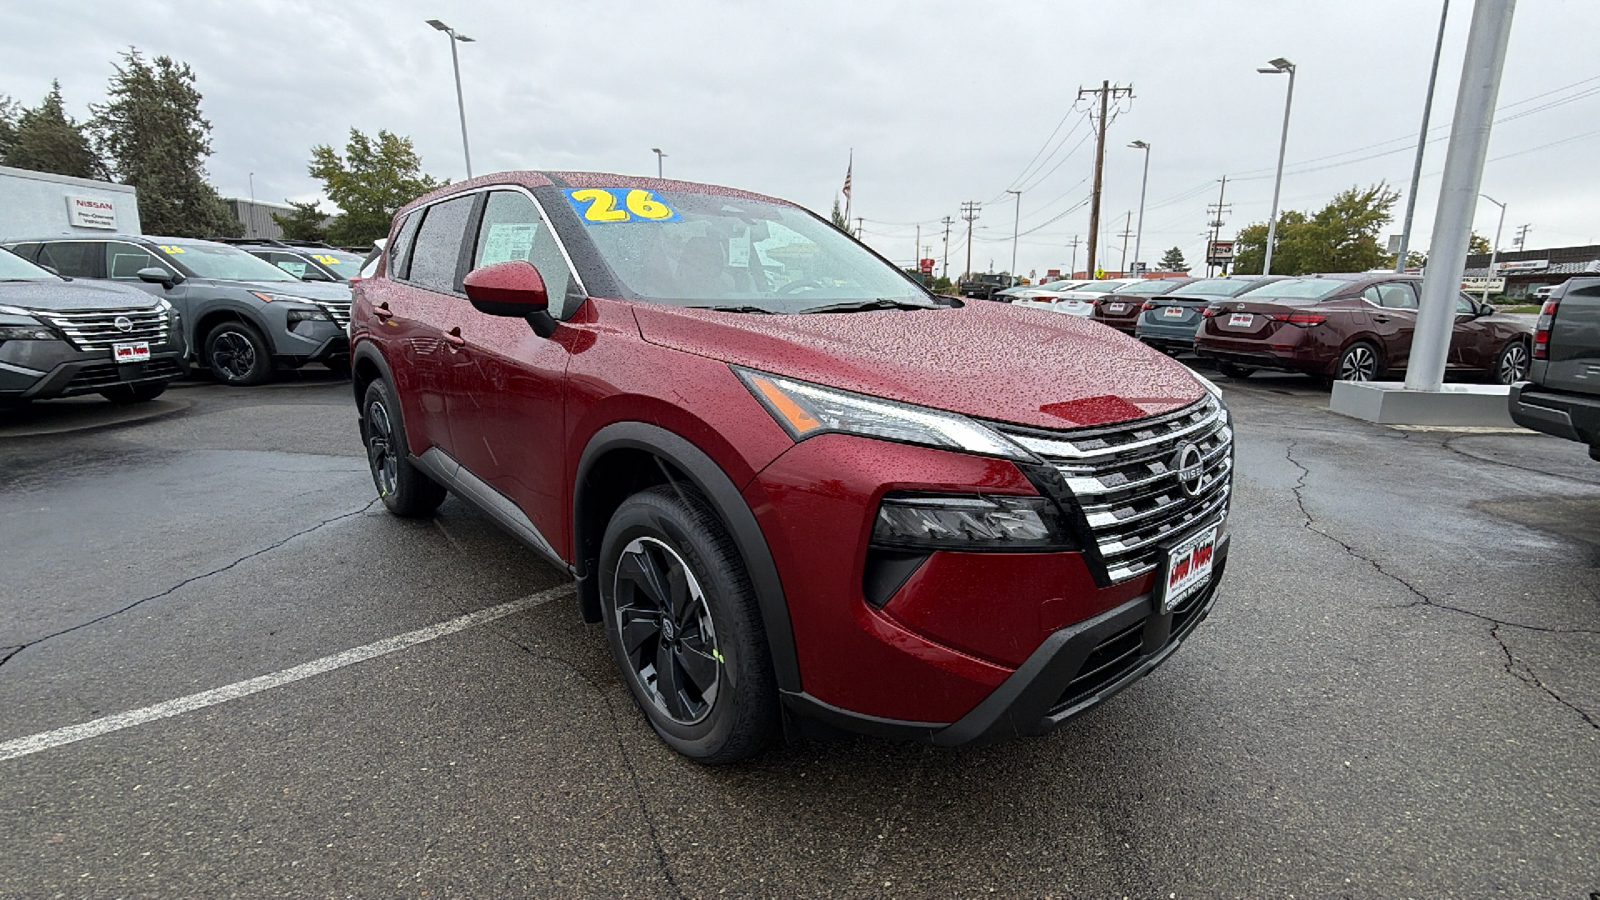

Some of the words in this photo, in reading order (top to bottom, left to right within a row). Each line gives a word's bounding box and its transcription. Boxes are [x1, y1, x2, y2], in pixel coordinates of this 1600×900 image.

[76, 200, 113, 210] NISSAN
[570, 189, 674, 222] 26
[78, 212, 114, 220] Pre-Owned
